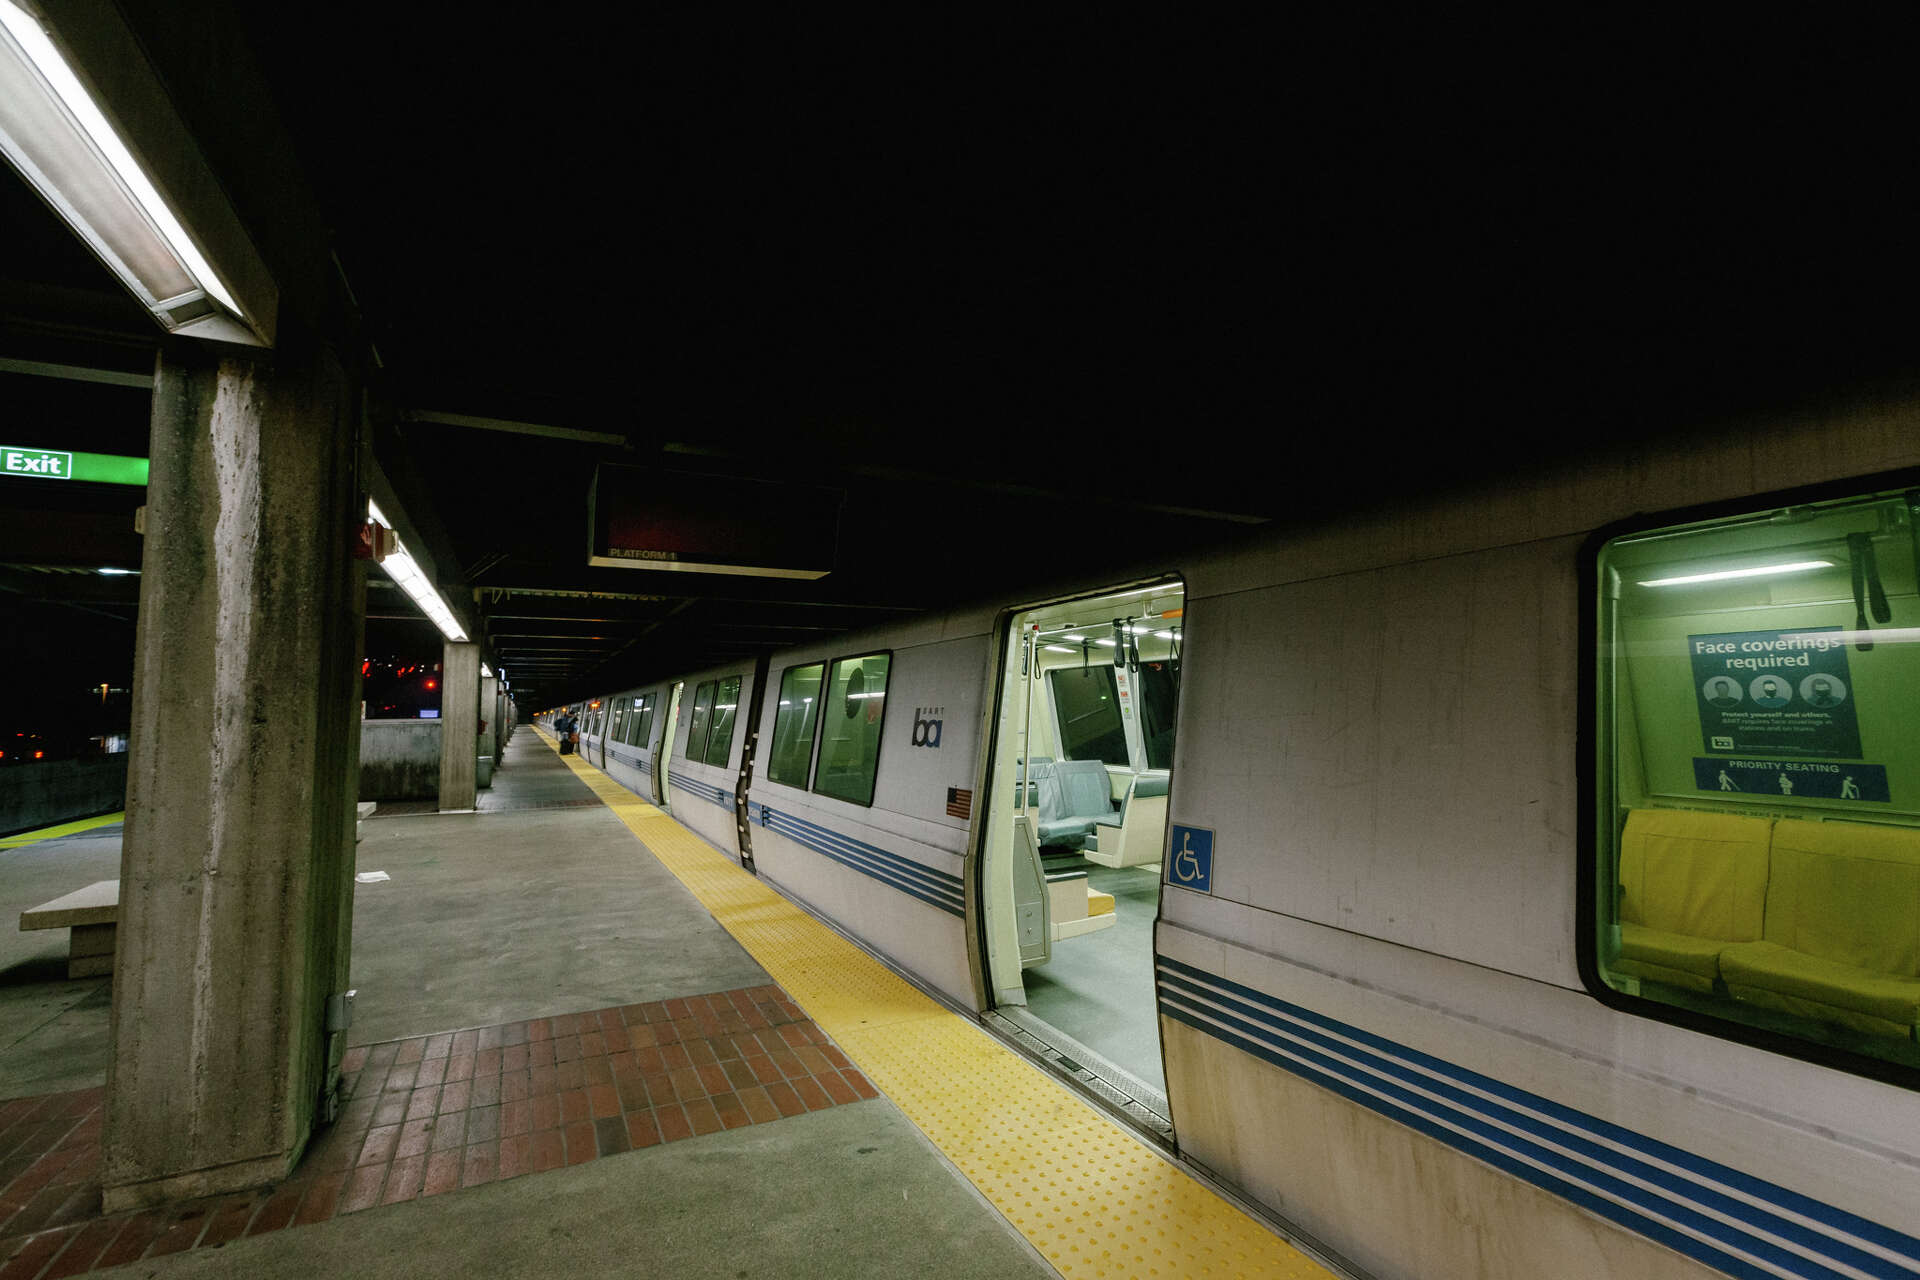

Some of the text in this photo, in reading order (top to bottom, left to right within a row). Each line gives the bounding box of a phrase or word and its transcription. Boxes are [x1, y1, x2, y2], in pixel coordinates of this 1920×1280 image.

[6, 452, 61, 474] Exit
[611, 548, 667, 560] PLATFORM
[1695, 636, 1841, 654] Face coverings
[1726, 653, 1810, 671] required
[1729, 760, 1840, 773] PRIORITY SEATING
